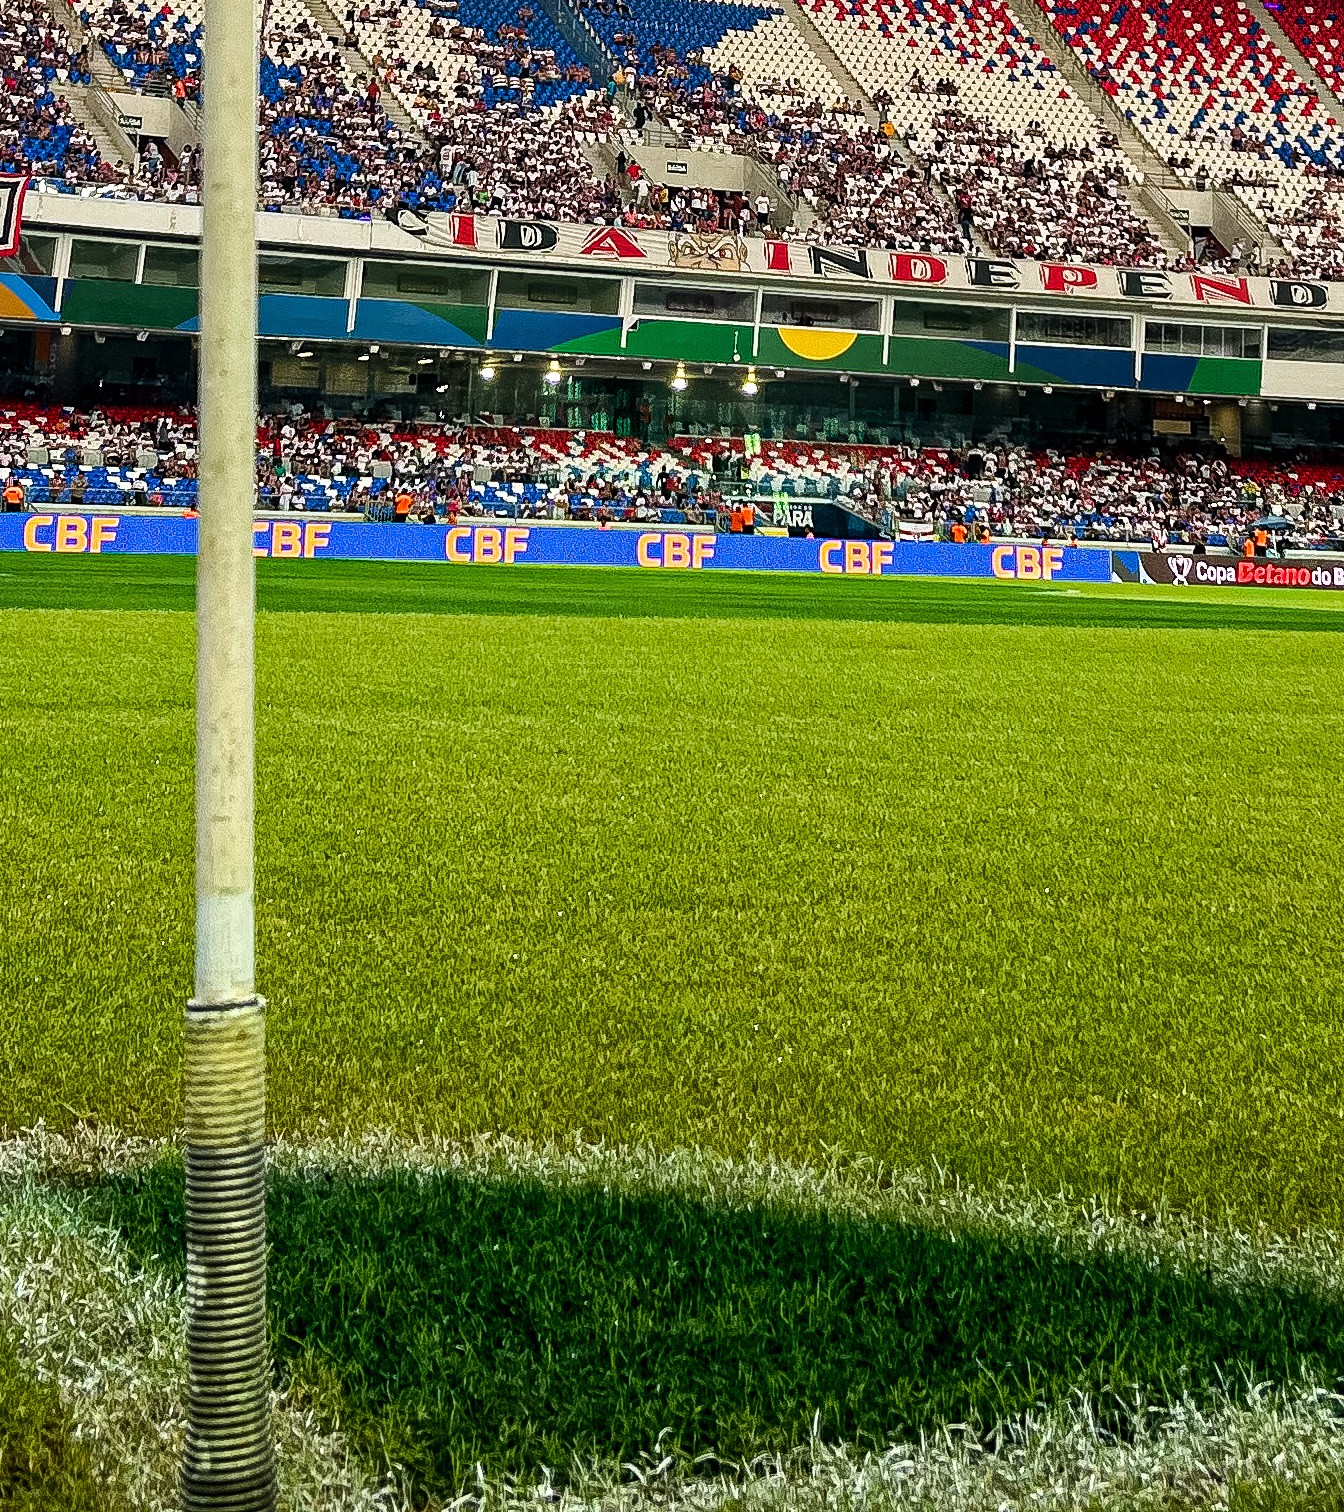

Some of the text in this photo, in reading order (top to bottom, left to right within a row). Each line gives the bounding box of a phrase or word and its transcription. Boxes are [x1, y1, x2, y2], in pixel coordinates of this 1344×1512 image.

[24, 515, 119, 553] CBF
[446, 527, 530, 564] CBF
[637, 533, 717, 569] CBF
[819, 539, 894, 574] CBF
[993, 546, 1063, 580] CBF
[1196, 561, 1236, 584] Copa
[1237, 561, 1310, 585] Betano
[1311, 567, 1331, 585] do
